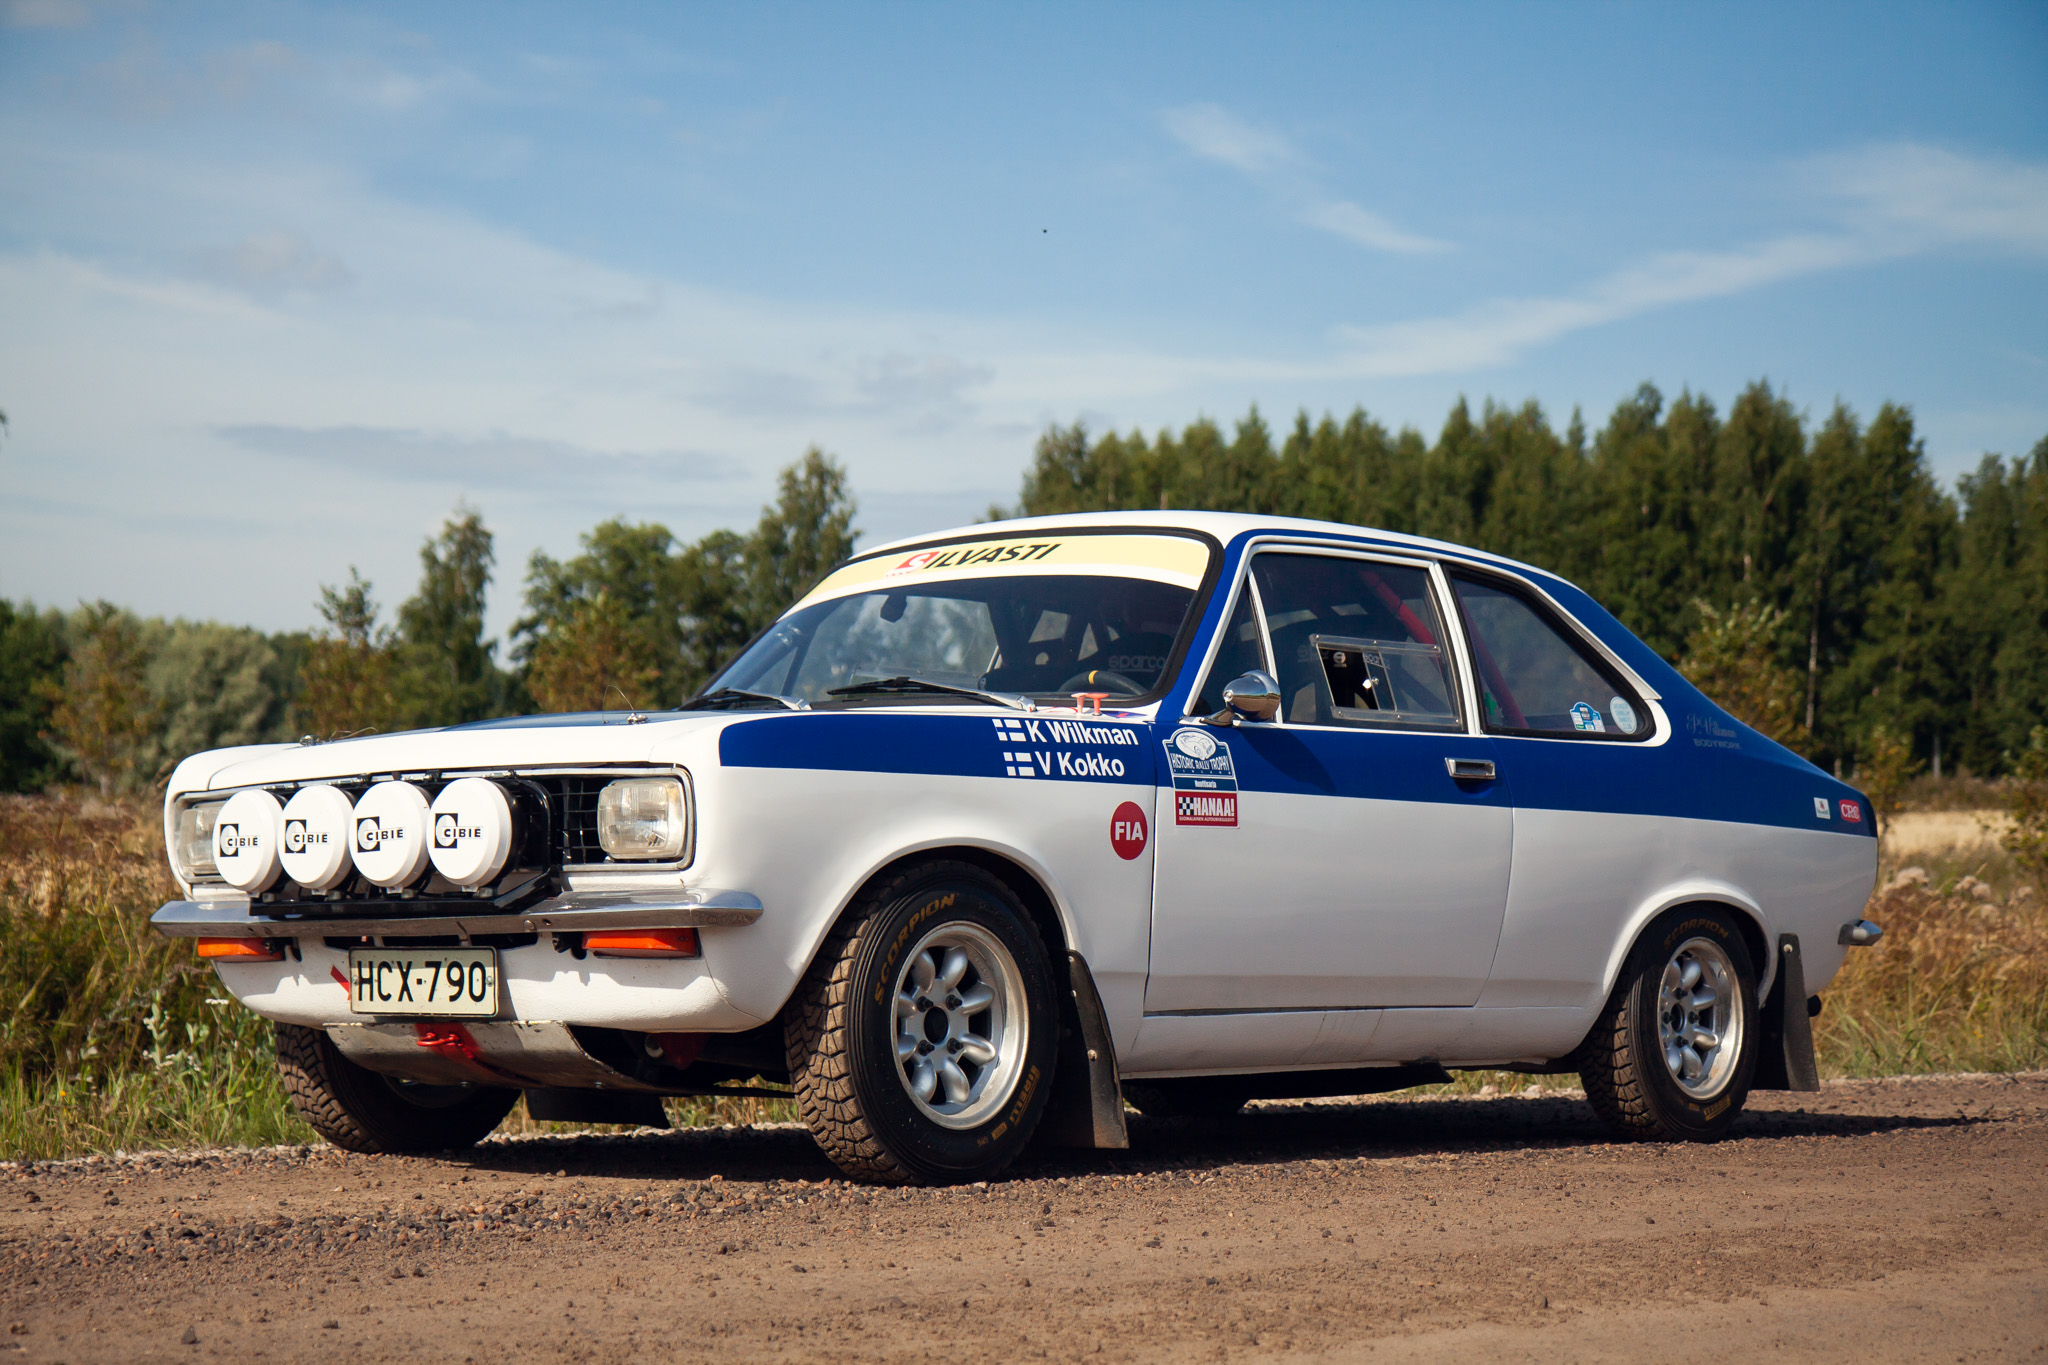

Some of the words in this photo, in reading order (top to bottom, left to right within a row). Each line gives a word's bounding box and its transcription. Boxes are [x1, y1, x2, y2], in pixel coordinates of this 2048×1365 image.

[897, 543, 1062, 570] SILVASTI
[1025, 720, 1047, 742] K
[1045, 721, 1139, 745] Wilkman
[1035, 751, 1050, 775] V
[1057, 752, 1125, 777] Kokko
[1170, 753, 1195, 769] HISTORIC
[1195, 760, 1210, 770] RALLY
[1210, 756, 1230, 771] TROPHY
[1193, 797, 1235, 817] HANAA!
[1841, 803, 1860, 819] CRC
[1114, 821, 1144, 841] FIA
[874, 892, 955, 1006] SCORPION
[357, 960, 487, 1002] HCX-790
